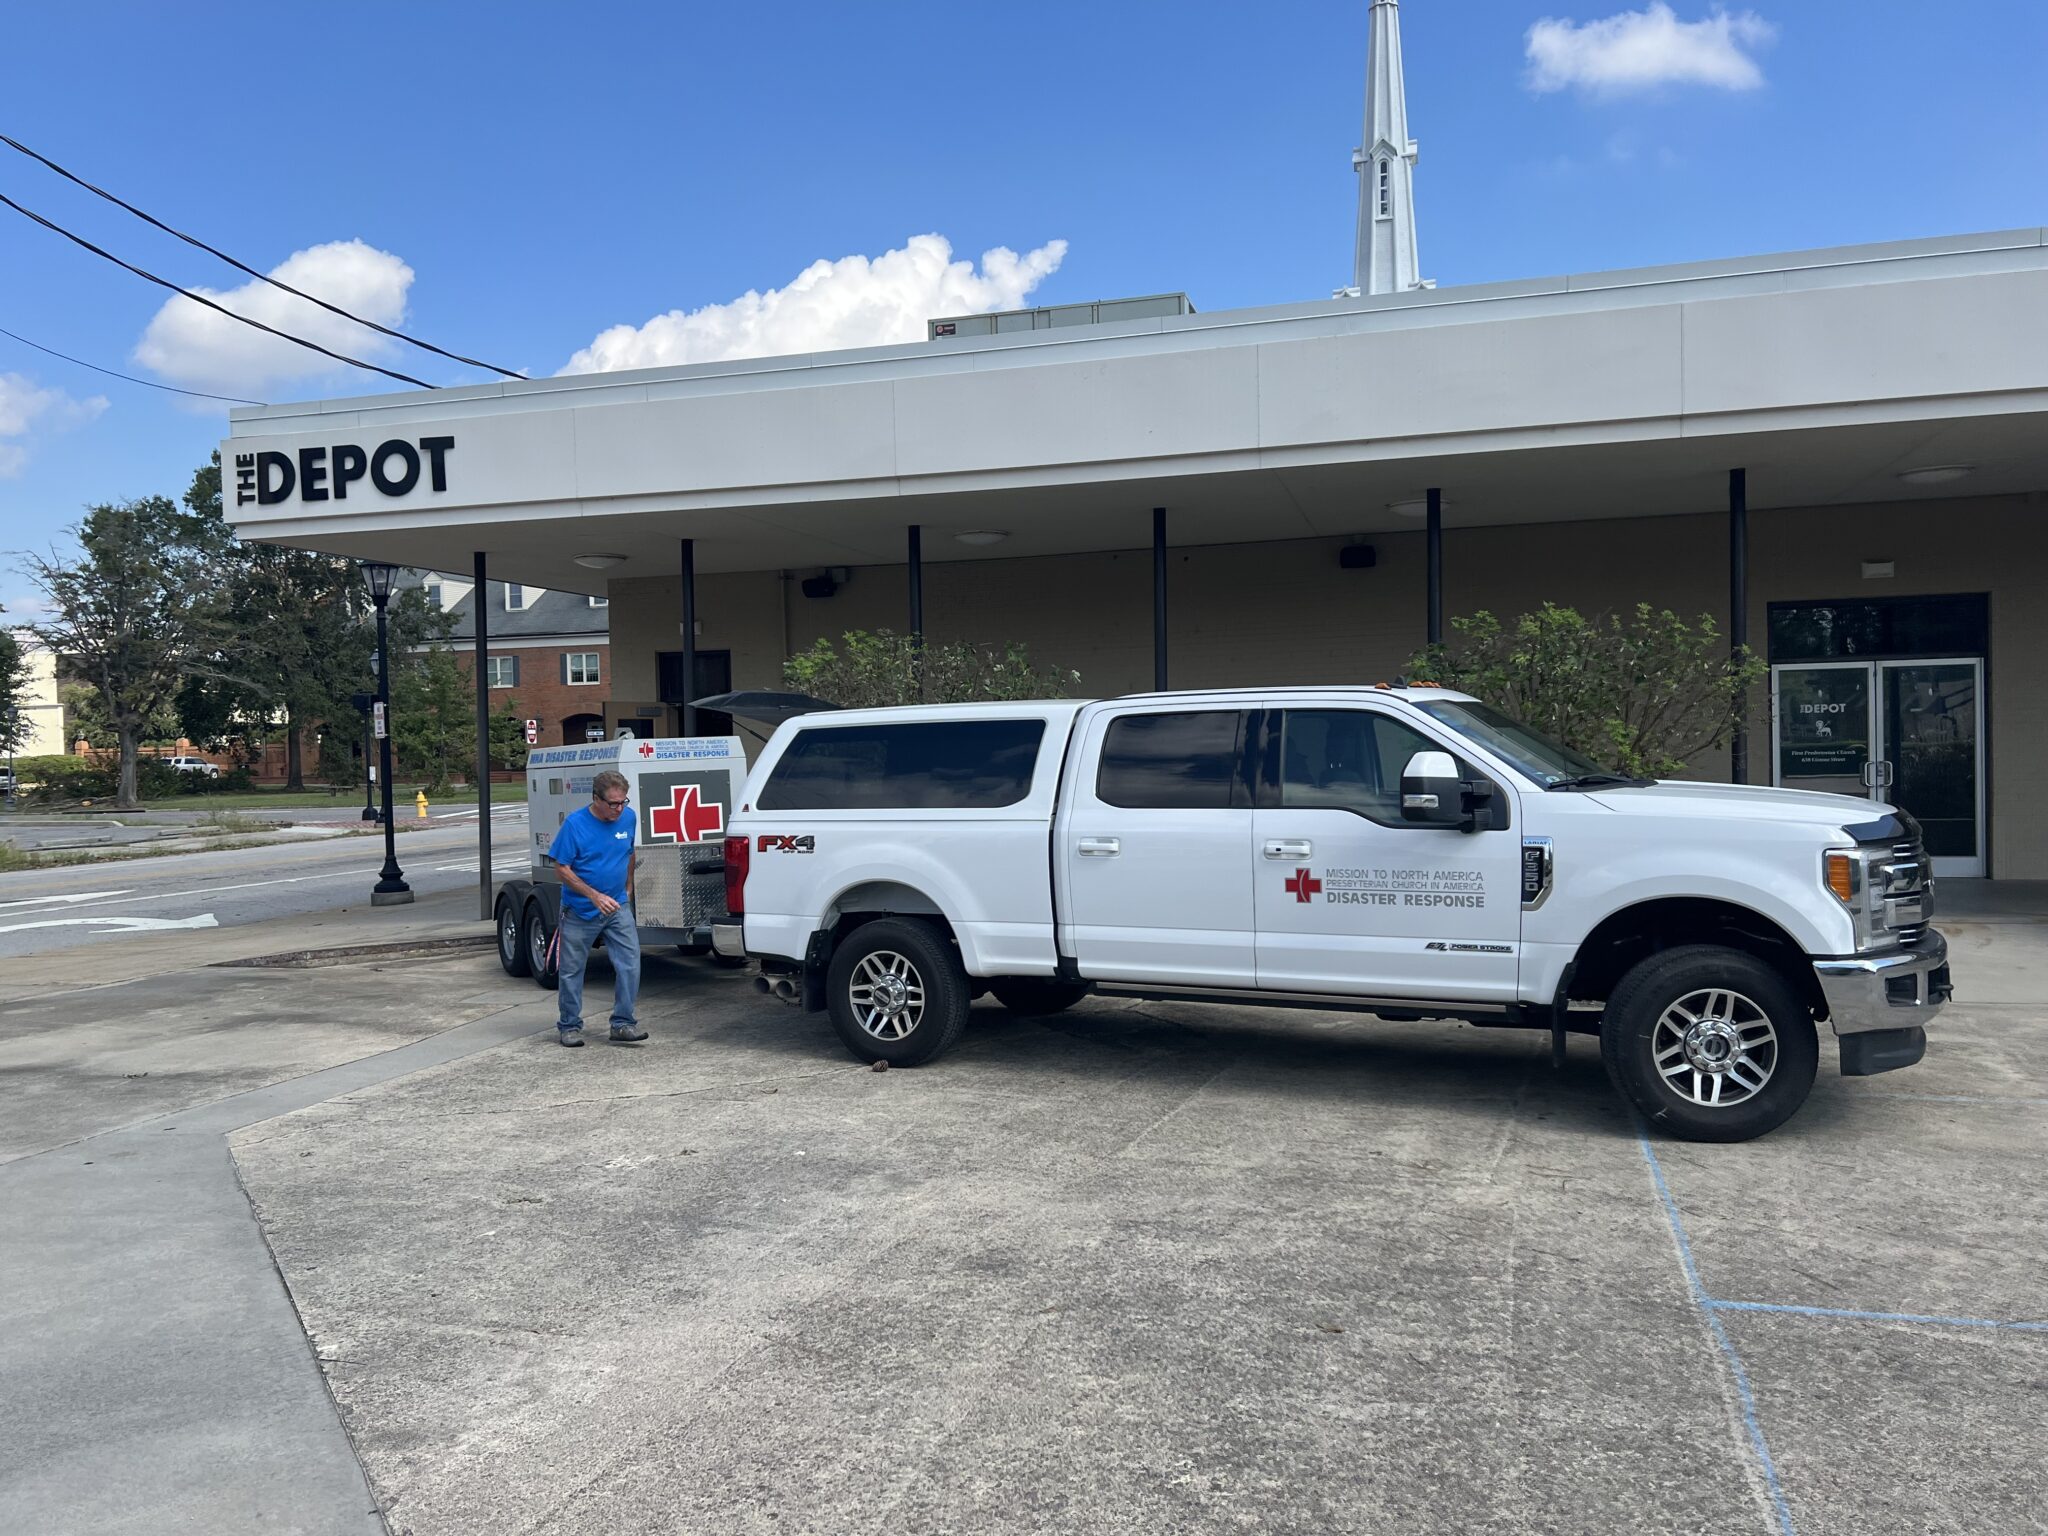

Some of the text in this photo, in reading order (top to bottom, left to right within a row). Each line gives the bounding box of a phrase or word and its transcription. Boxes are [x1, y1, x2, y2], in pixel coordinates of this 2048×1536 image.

[257, 436, 455, 505] DEPOT
[236, 453, 255, 506] THE
[1804, 703, 1846, 713] DEPOT
[545, 751, 577, 763] DISASTER
[579, 746, 619, 760] RESPONSE
[656, 750, 729, 759] DISASTER RESPONSE
[757, 835, 815, 852] FX4
[1326, 868, 1484, 882] MISSION TO NORTH AMERICA
[1326, 879, 1484, 891] PRESBYTERIAN CHURCH IN AMERICA
[1326, 892, 1485, 908] DISASTER RESPONSE
